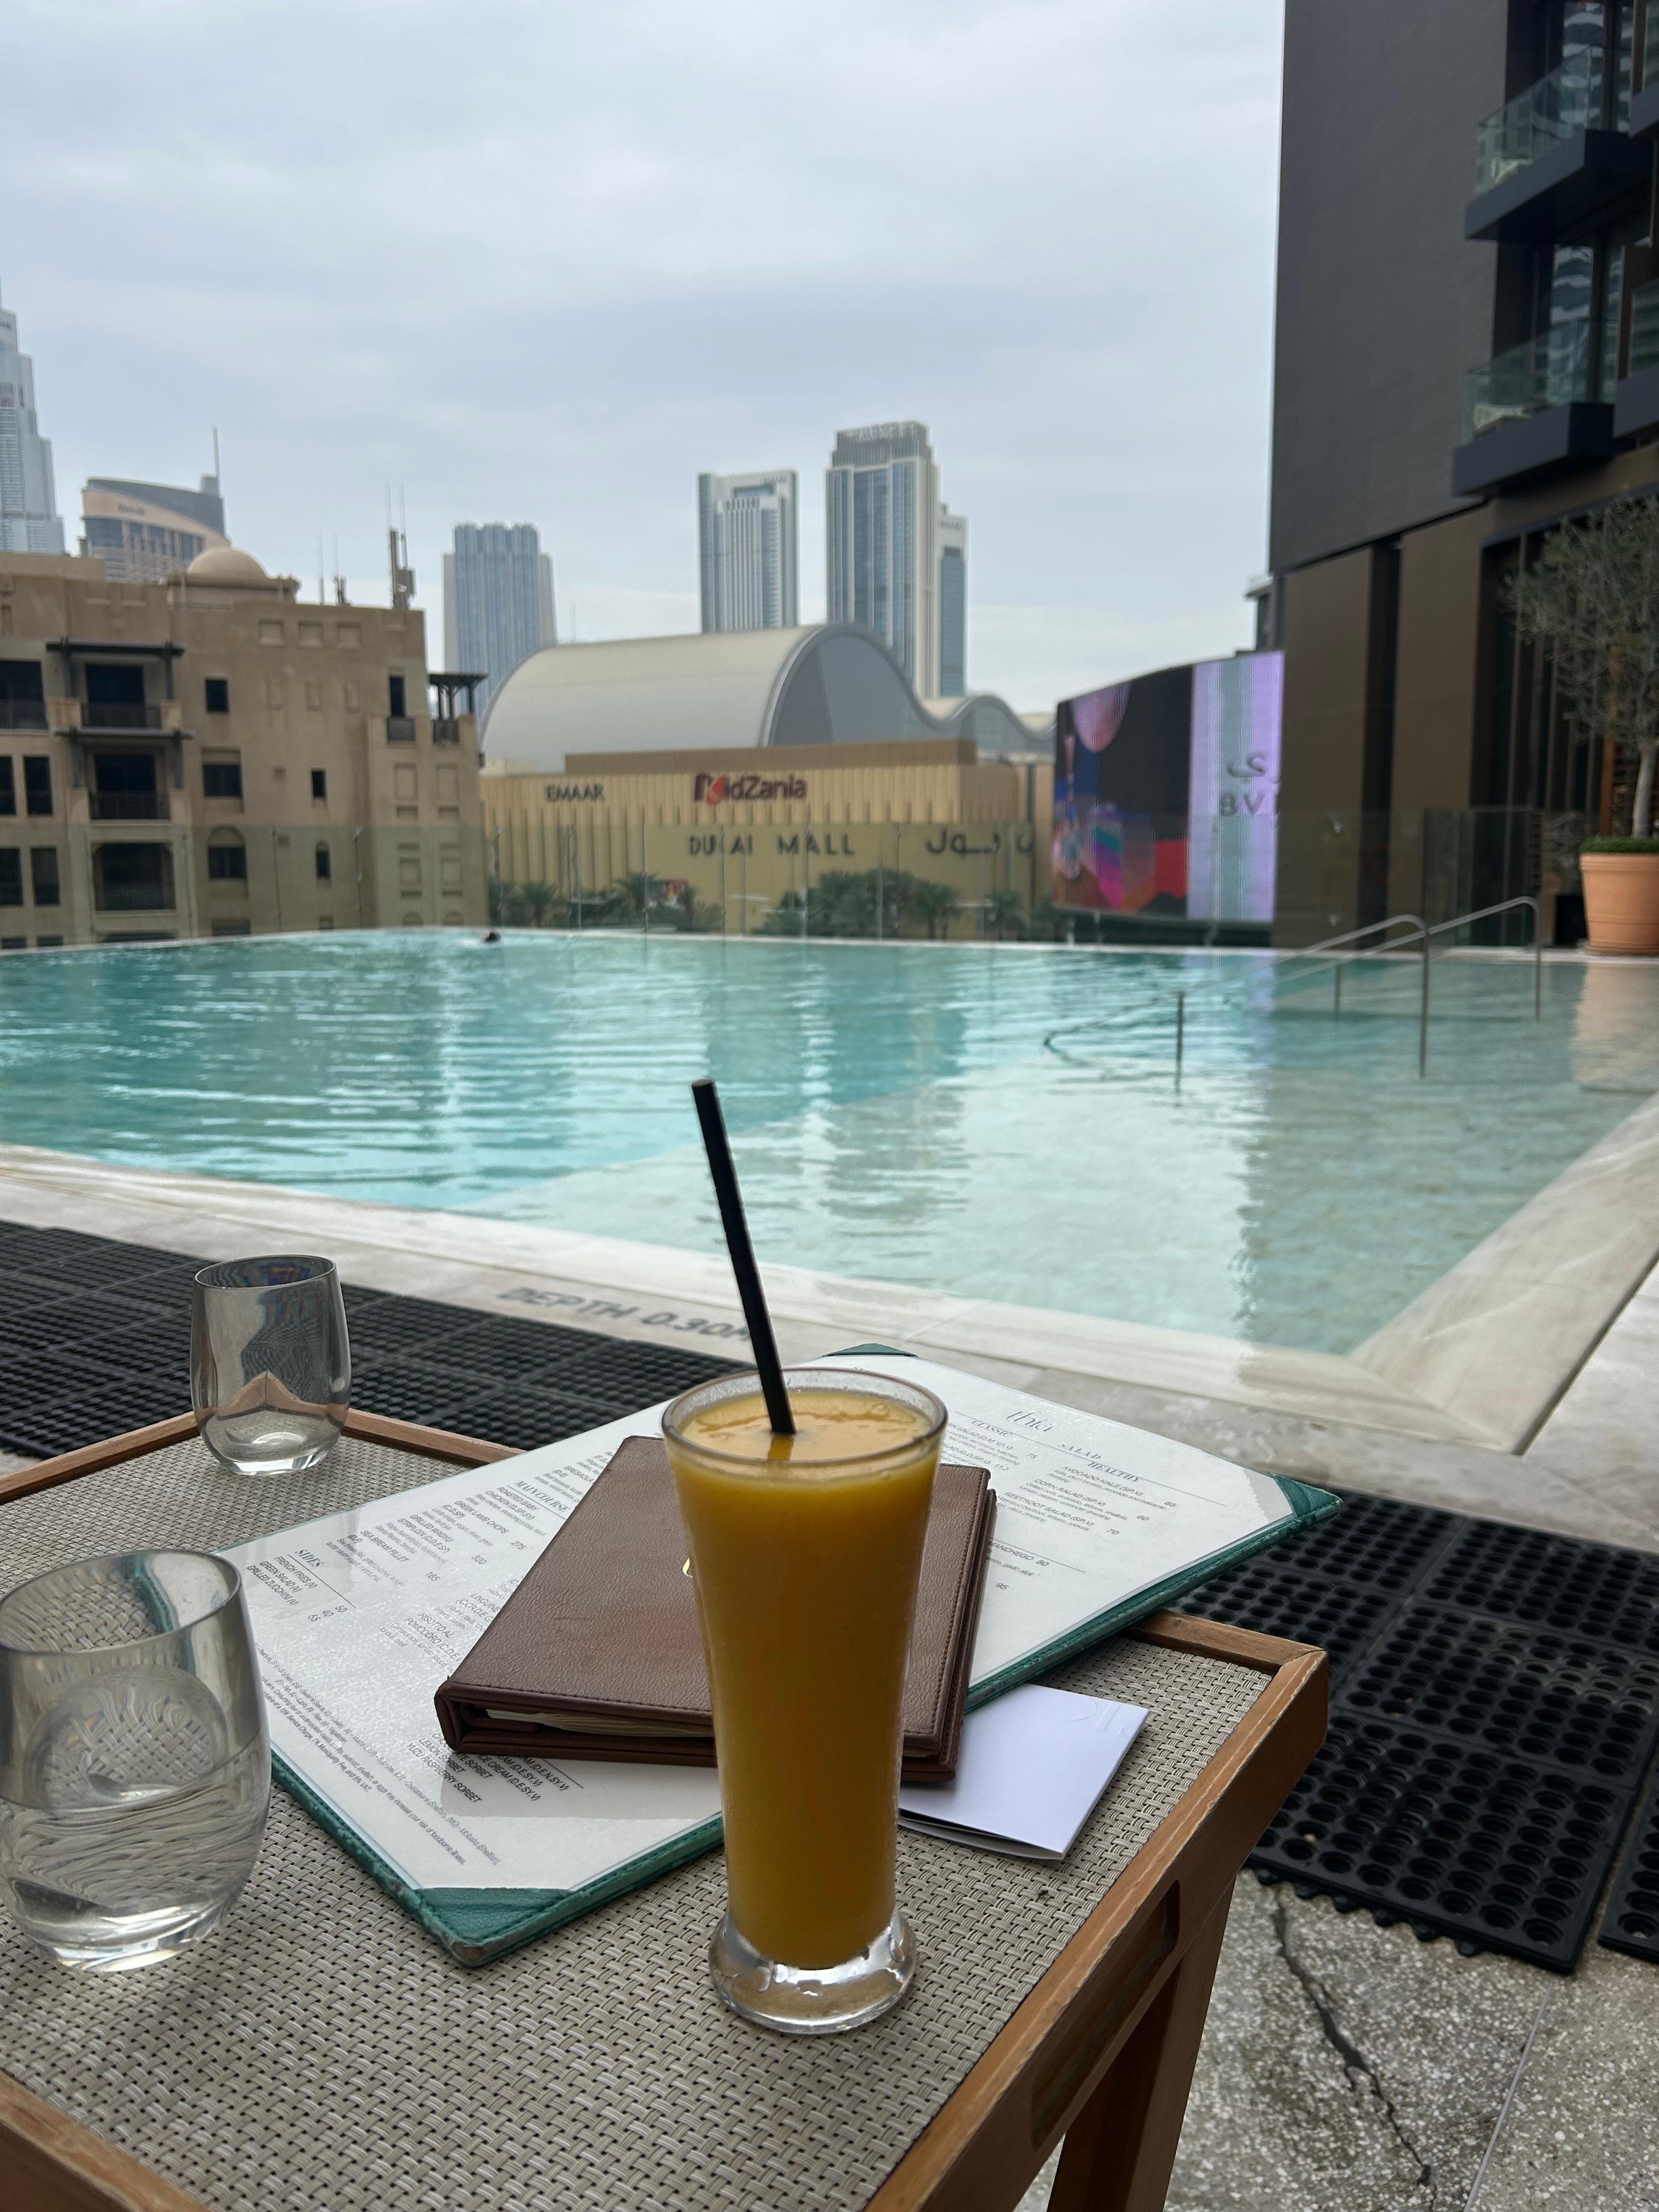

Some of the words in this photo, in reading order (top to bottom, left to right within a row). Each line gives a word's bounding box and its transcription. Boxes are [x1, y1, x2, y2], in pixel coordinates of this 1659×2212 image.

[545, 782, 605, 803] EMAAR
[695, 774, 808, 805] KidZania
[690, 833, 754, 856] DUAI
[777, 832, 855, 856] MALL
[497, 1285, 641, 1320] DEPTH
[956, 1426, 980, 1437] SALAD
[971, 1420, 1013, 1436] CLASSIC
[1006, 1409, 1054, 1434] thia
[1057, 1443, 1102, 1459] SALAD
[1061, 1466, 1100, 1480] AVOCADO
[1098, 1479, 1121, 1488] KALE
[1087, 1462, 1142, 1482] HEALTHY
[485, 1491, 511, 1505] CHICKEN
[496, 1487, 524, 1502] ROASTED
[520, 1500, 540, 1511] BABY
[516, 1481, 538, 1494] MAIN
[534, 1492, 571, 1512] COURSE
[1034, 1479, 1058, 1488] CORN
[1056, 1487, 1084, 1498] SALAD
[1003, 1492, 1046, 1508] BEETROOT
[1044, 1506, 1071, 1517] SALAD
[397, 1518, 427, 1536] STRIPLOIN
[454, 1500, 476, 1513] GREEK
[471, 1511, 490, 1522] LAMB
[486, 1520, 509, 1534] CHOPS
[510, 1541, 527, 1550] 275
[410, 1514, 435, 1530] GRILLED
[430, 1527, 454, 1542] WAGYU
[471, 1555, 487, 1565] 320
[294, 1549, 325, 1567] SIDES
[360, 1530, 375, 1539] SEA
[370, 1537, 393, 1551] BREAM
[387, 1549, 410, 1562] FILLET
[425, 1572, 441, 1581] 165
[259, 1561, 280, 1575] GREEN
[274, 1573, 296, 1587] SALAD
[274, 1556, 298, 1572] FRENCH
[292, 1570, 312, 1583] FRIES
[335, 1605, 348, 1613] 50
[246, 1565, 270, 1581] GRILLED
[264, 1579, 294, 1600] ZUCCHINI
[307, 1613, 321, 1622] 55
[470, 1593, 503, 1612] LINGUINE
[404, 1618, 442, 1644] POMODORO
[417, 1612, 447, 1632] RISOTTO
[418, 1738, 443, 1756] LEMON
[439, 1755, 466, 1774] SORBET
[406, 1742, 426, 1757] YUZU
[422, 1756, 459, 1784] RASPBERRY
[453, 1782, 482, 1803] SORBET
[464, 1758, 493, 1779] SORBET
[486, 1760, 514, 1779] CREAM
